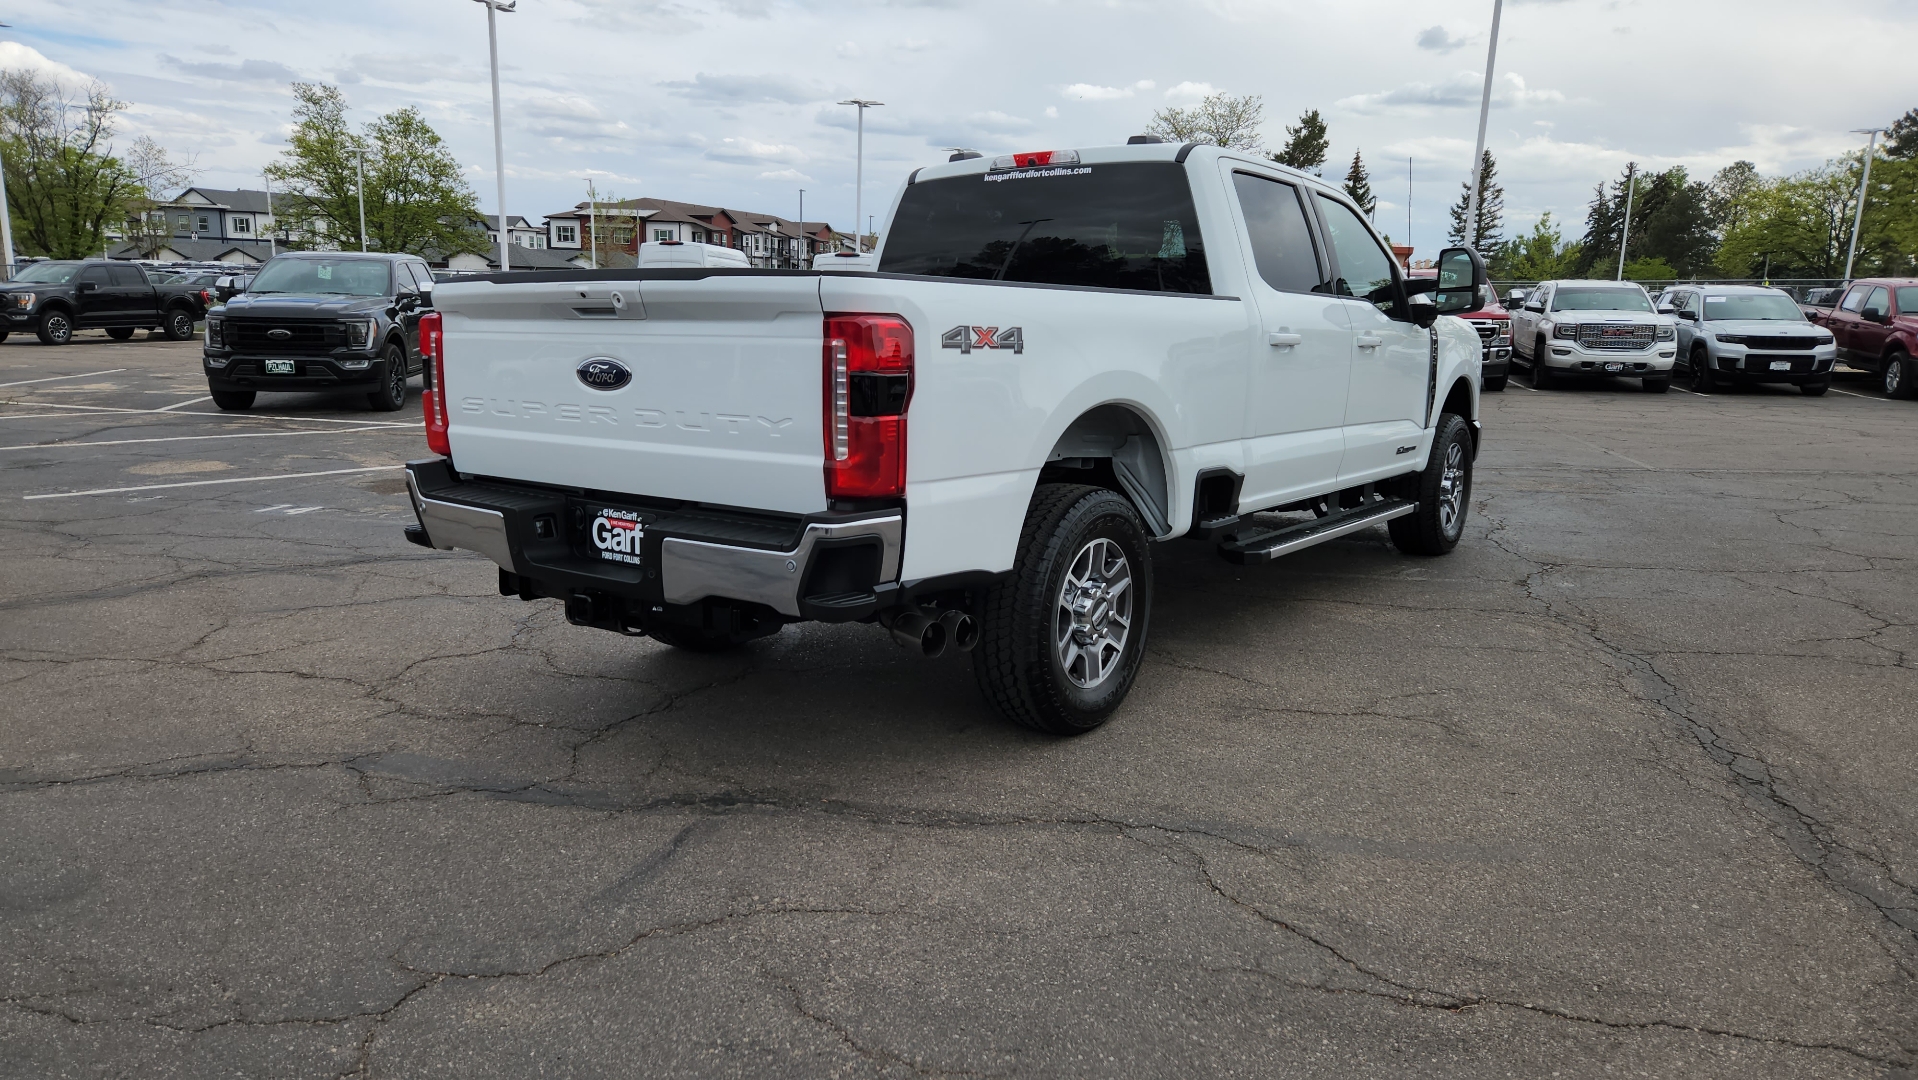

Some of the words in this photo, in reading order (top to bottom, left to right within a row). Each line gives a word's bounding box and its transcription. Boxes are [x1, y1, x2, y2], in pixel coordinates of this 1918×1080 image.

[984, 167, 1092, 182] kengarfffordfortcollins.com
[587, 364, 617, 383] Ford
[461, 397, 618, 425] SUPER
[634, 408, 793, 437] DUTY
[602, 551, 612, 560] FORD
[613, 553, 623, 561] FORT
[624, 555, 640, 565] COLLINS
